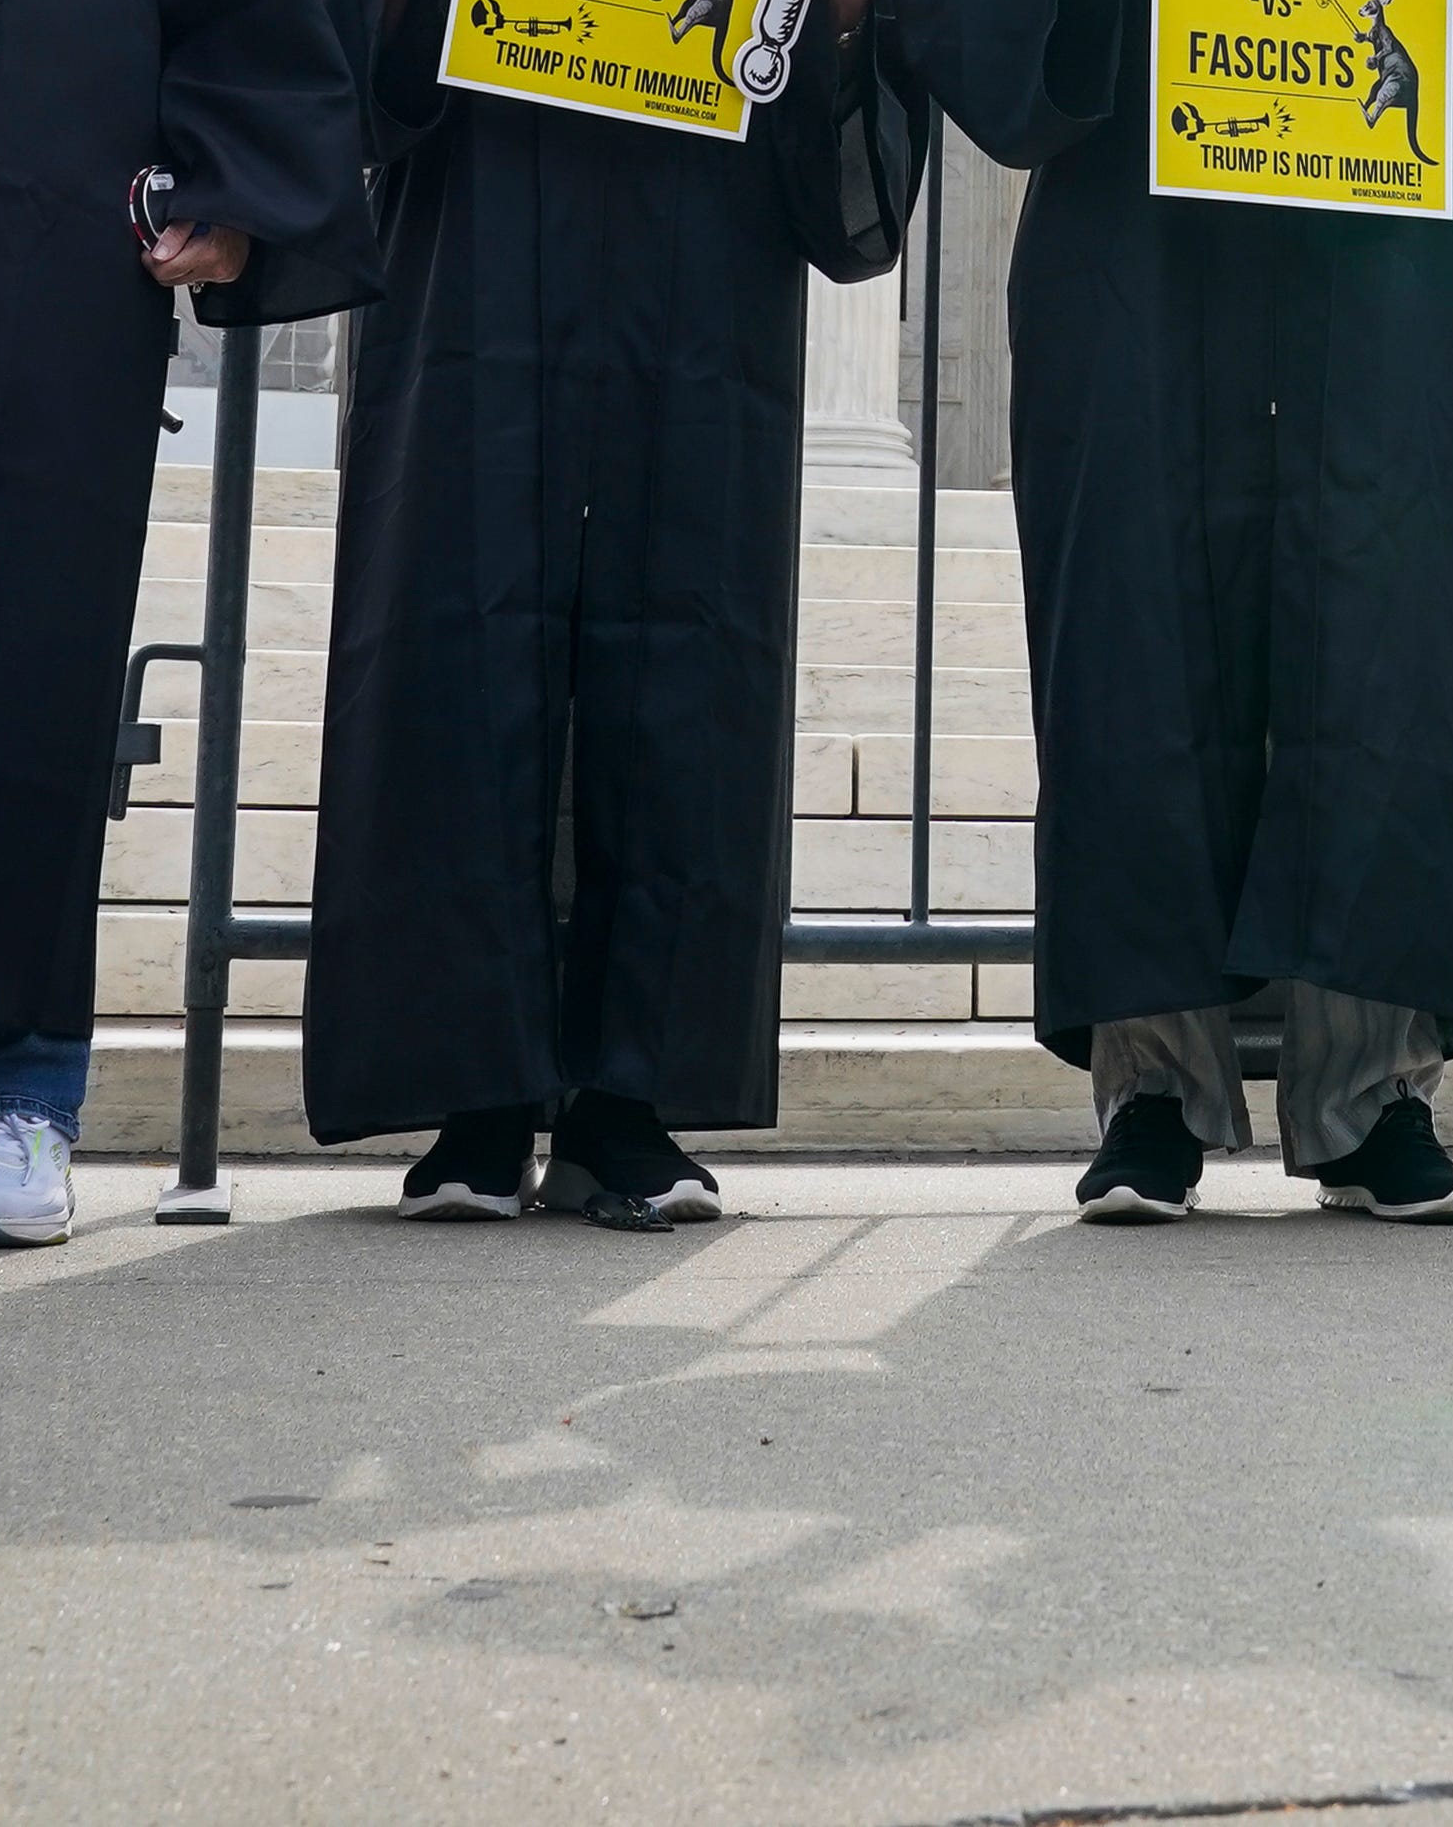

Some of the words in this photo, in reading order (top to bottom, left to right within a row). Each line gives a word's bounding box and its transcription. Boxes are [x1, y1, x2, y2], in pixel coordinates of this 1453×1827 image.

[496, 40, 563, 75] TRUMP
[568, 55, 586, 80] IS
[591, 60, 631, 89] NOT
[634, 68, 722, 107] IMMUNE!
[1190, 32, 1354, 88] FASCISTS
[1200, 144, 1267, 173] TRUMP
[1274, 151, 1290, 175] IS
[1297, 153, 1333, 179] NOT
[1340, 157, 1421, 187] IMMUNE!
